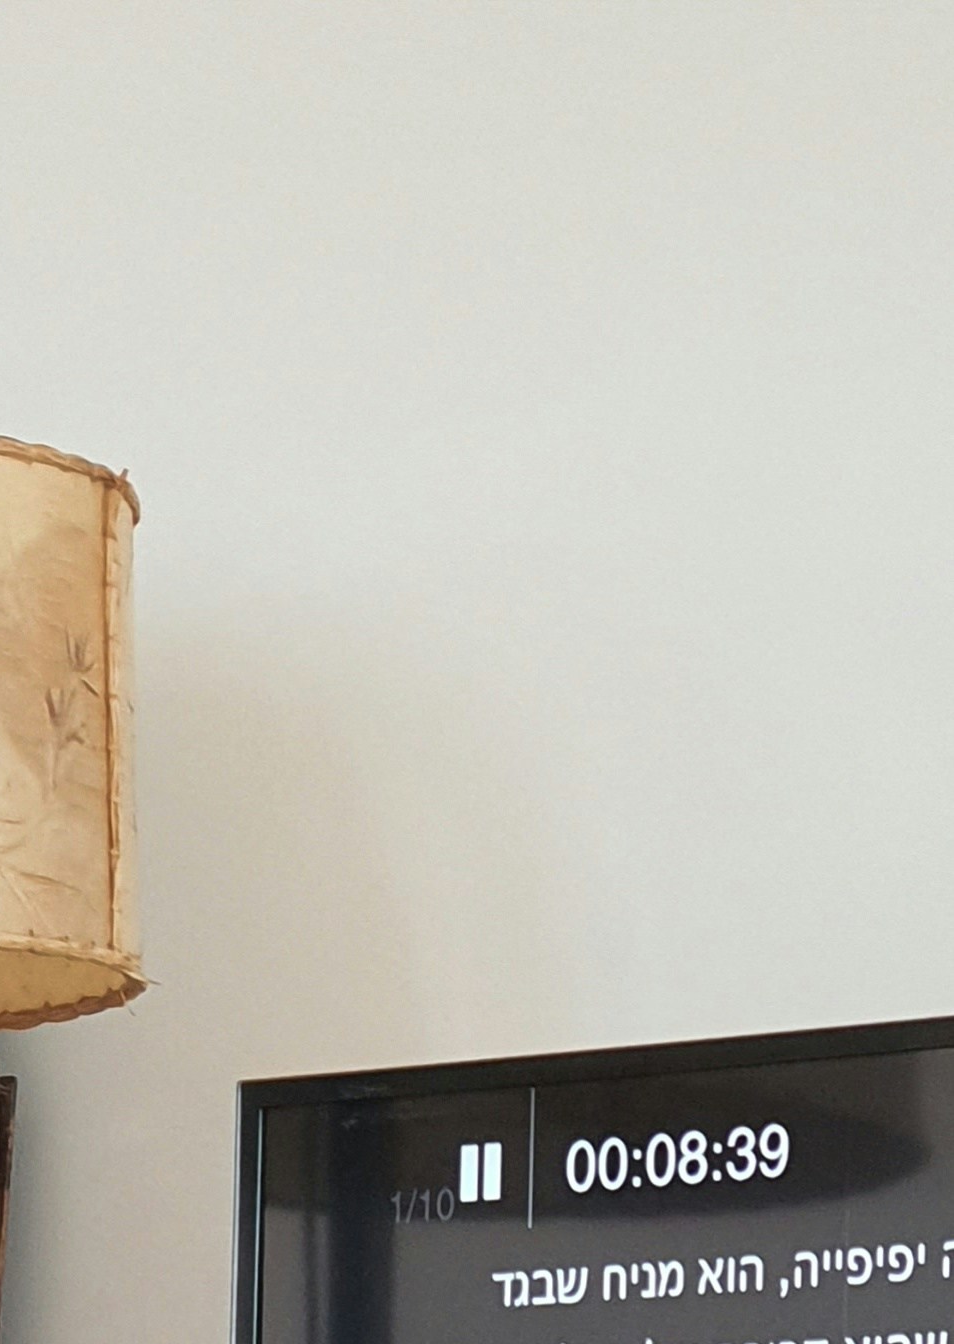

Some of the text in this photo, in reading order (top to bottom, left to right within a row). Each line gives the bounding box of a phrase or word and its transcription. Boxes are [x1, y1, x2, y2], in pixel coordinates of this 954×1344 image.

[563, 1121, 791, 1195] 00:08:39
[390, 1187, 456, 1226] 1/10
[492, 1266, 588, 1309] שבגד
[602, 1262, 684, 1301] מניח
[697, 1253, 764, 1296] הוא
[778, 1246, 926, 1299] יפיפייה,
